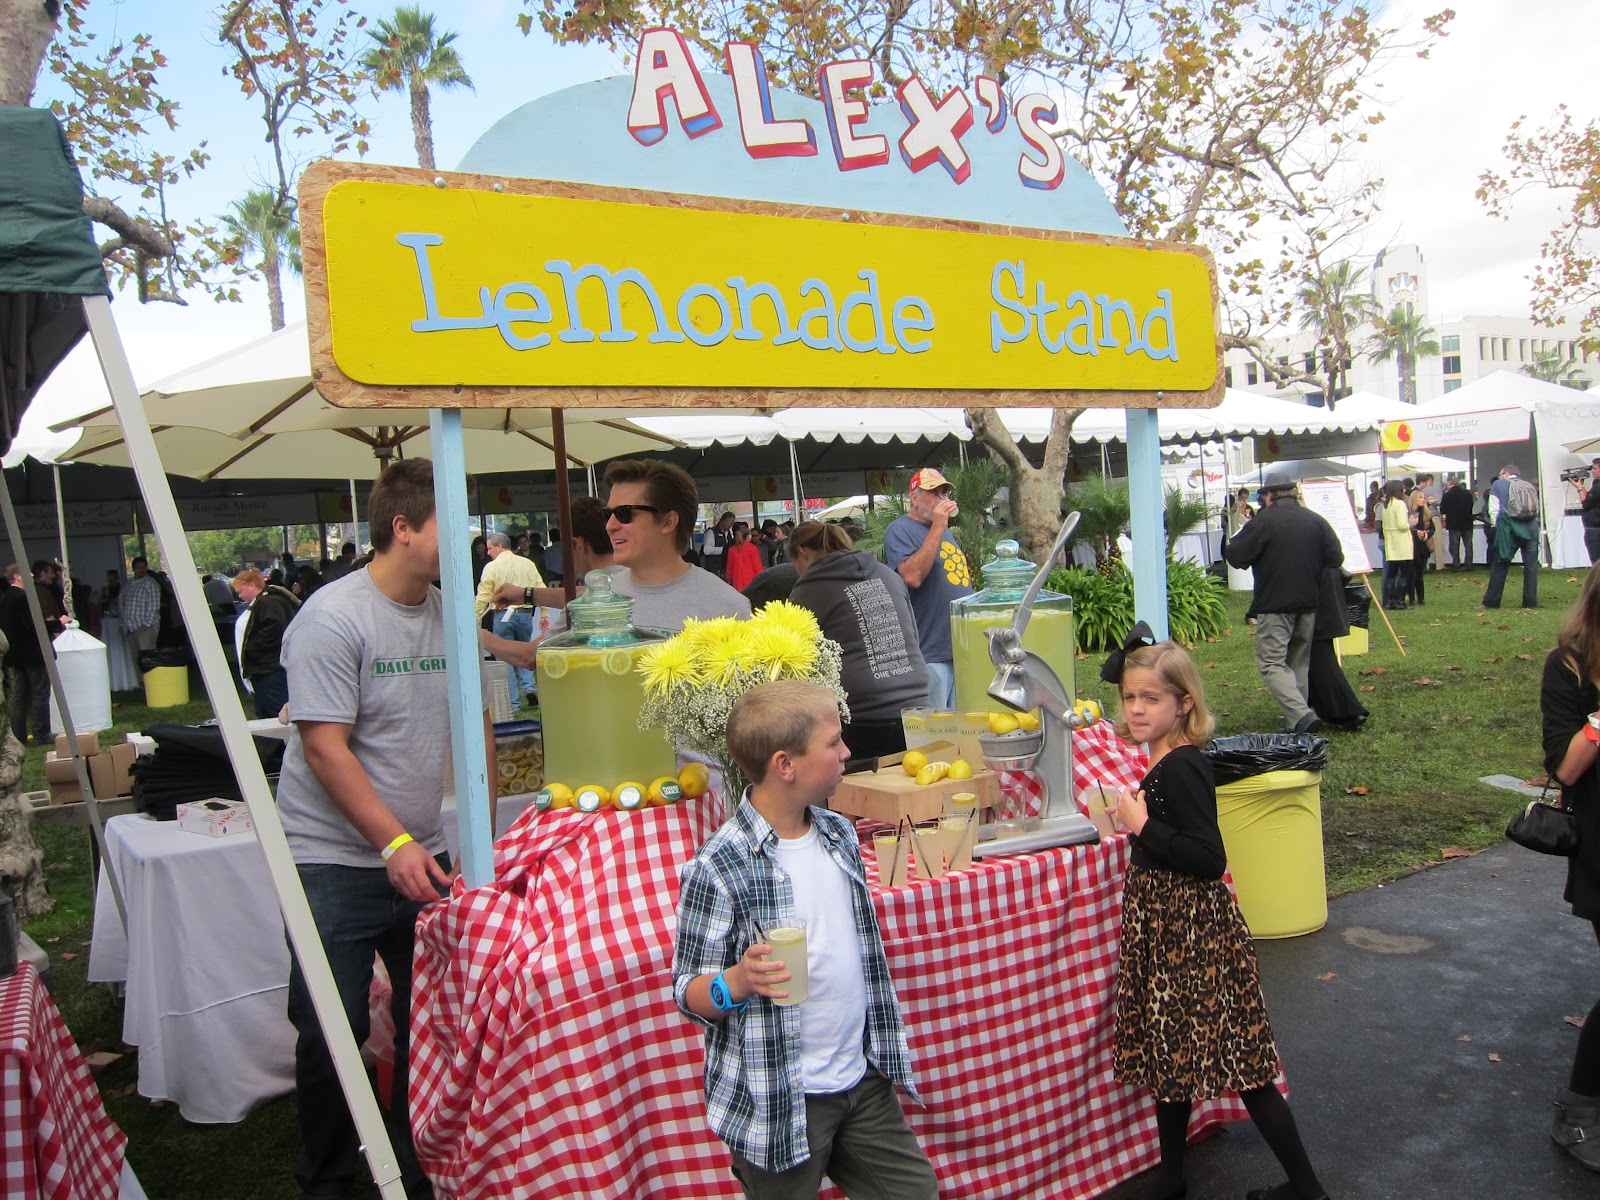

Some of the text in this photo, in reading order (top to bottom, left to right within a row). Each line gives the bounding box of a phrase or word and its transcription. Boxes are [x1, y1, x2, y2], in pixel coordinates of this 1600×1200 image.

[627, 26, 1065, 190] ALEX'S
[396, 233, 1178, 361] Lemonade Stand
[1427, 419, 1480, 431] David Lentz
[193, 501, 266, 512] Russell Moore
[24, 510, 70, 521] Welcoe
[75, 519, 127, 529] Lemonade
[843, 586, 868, 634] TWENTY-TWO
[862, 635, 878, 674] VARIETIES.
[376, 660, 414, 674] DAILY
[874, 665, 915, 680] ONE VISION.
[218, 810, 237, 826] SYSCO
